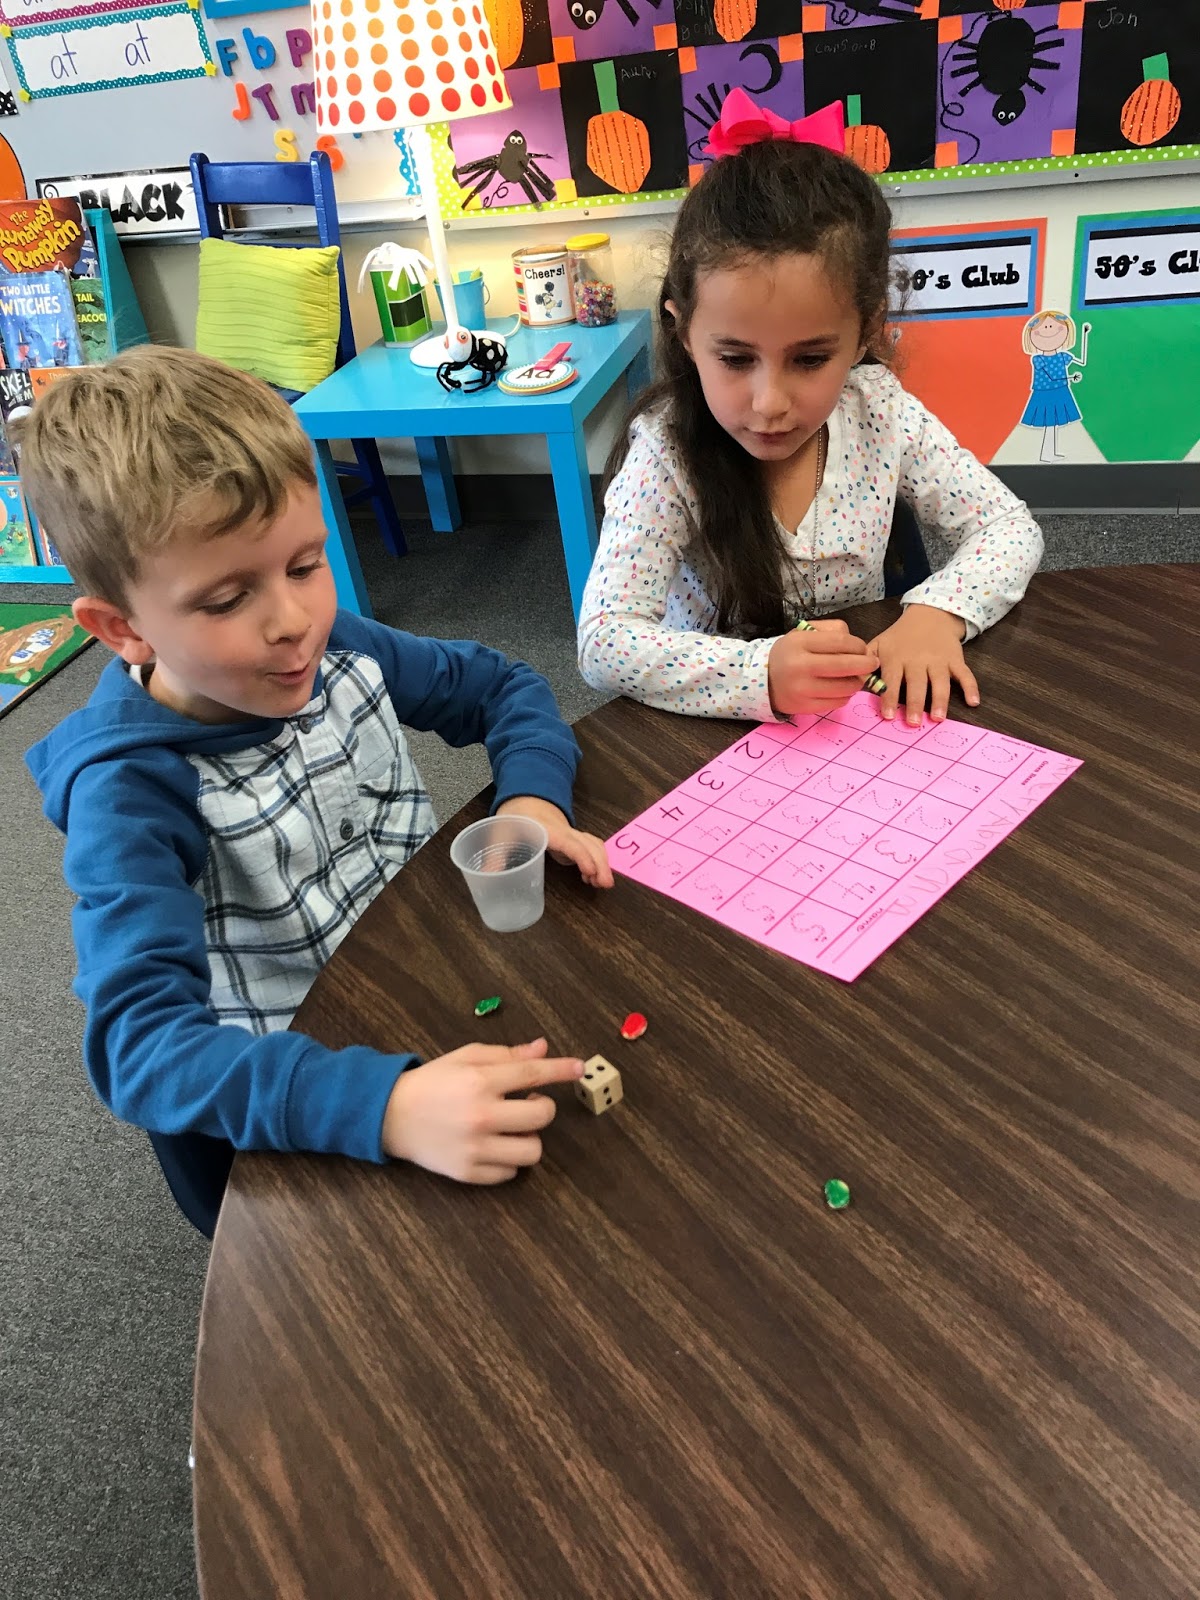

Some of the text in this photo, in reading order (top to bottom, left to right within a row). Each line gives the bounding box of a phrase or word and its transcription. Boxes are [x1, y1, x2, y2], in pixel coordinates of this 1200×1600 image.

[1098, 6, 1137, 29] Jon
[50, 22, 151, 79] at at
[215, 38, 239, 77] F
[242, 27, 276, 70] b
[232, 81, 251, 121] J
[251, 83, 280, 121] T
[0, 198, 55, 248] Runaway
[10, 210, 29, 226] The
[3, 219, 81, 273] Pumpkin
[524, 264, 566, 280] Cheers!
[961, 263, 1020, 288] Club
[1095, 249, 1200, 279] 50's Cl
[0, 283, 51, 296] TWO LITTLE
[75, 293, 95, 302] TAIL
[0, 295, 62, 317] WITCHES
[77, 312, 107, 323] EACOC
[516, 367, 556, 379] Aa
[614, 740, 764, 856] 2 3 4 5
[856, 907, 884, 932] name
